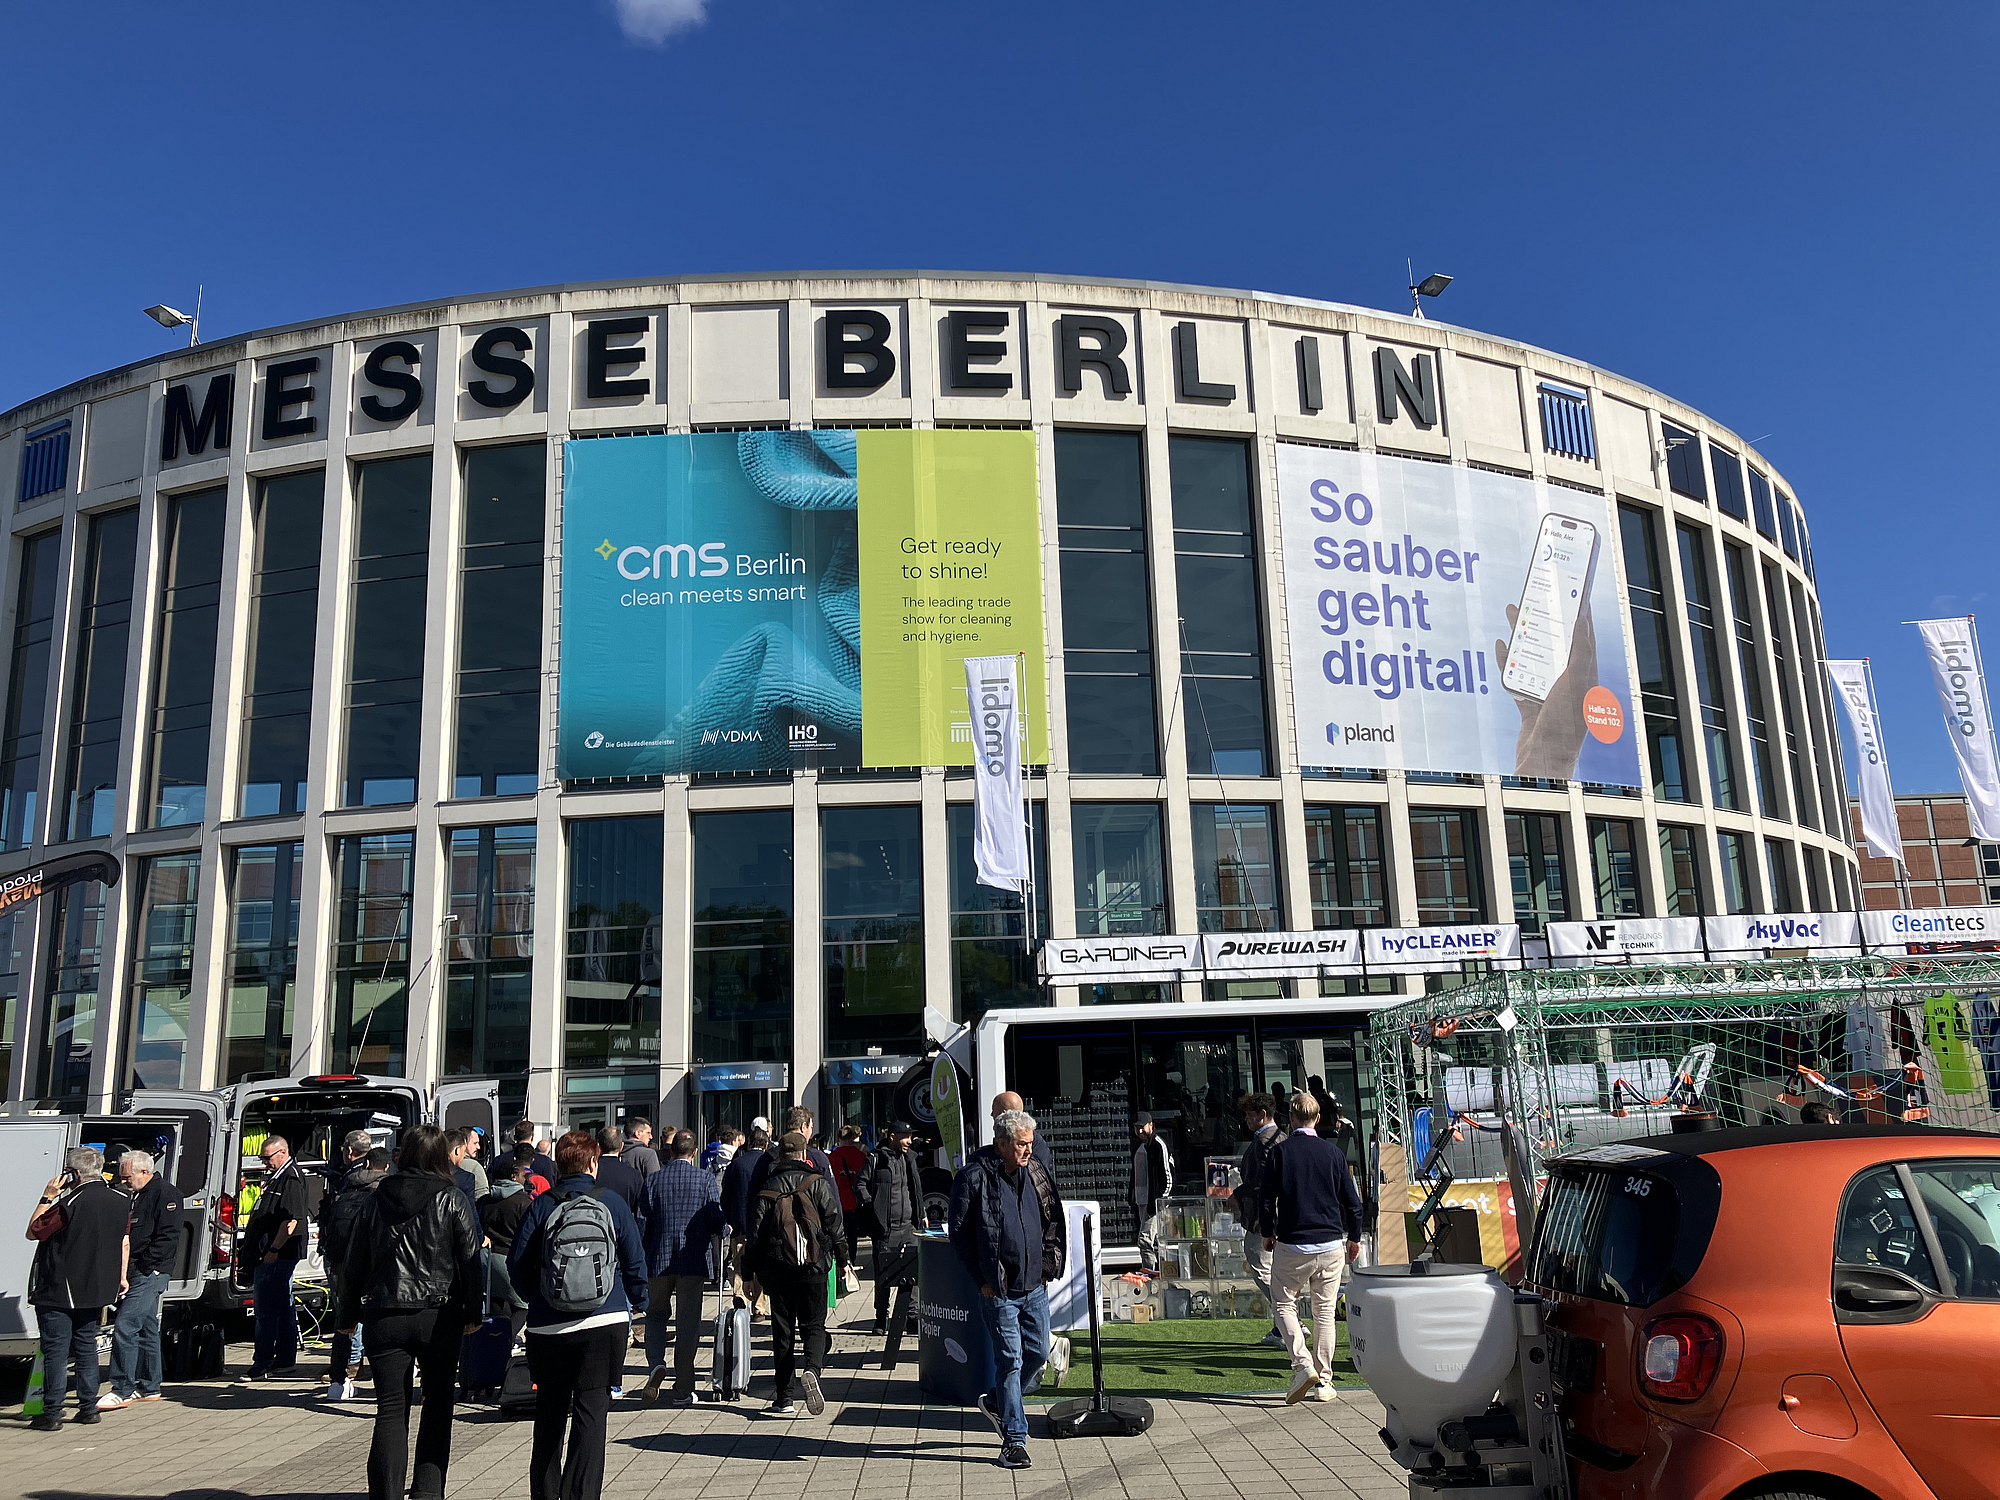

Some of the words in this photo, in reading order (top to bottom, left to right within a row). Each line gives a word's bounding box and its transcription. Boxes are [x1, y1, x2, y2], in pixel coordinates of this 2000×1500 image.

[161, 317, 651, 461] MESSE
[825, 309, 1438, 425] BERLIN
[1310, 479, 1373, 526] So
[901, 537, 938, 555] Get
[945, 537, 1002, 559] ready
[617, 542, 729, 580] cms
[736, 554, 806, 576] Berlin
[1314, 534, 1480, 583] sauber
[902, 563, 923, 579] to
[929, 561, 988, 579] shine!
[620, 588, 673, 607] clean
[679, 586, 743, 604] meets
[747, 583, 806, 601] smart
[902, 596, 925, 608] The
[928, 596, 974, 612] leading
[977, 596, 1011, 608] trade
[1317, 584, 1432, 635] geht
[902, 613, 935, 625] show
[938, 612, 955, 625] for
[959, 612, 1012, 628] cleaning
[902, 630, 926, 642] and
[930, 629, 982, 645] hygiene.
[1322, 640, 1489, 700] digital!
[1939, 640, 1976, 737] lidomo
[1588, 705, 1605, 714] Halle
[1606, 707, 1617, 716] 3.2
[981, 678, 1011, 777] lidomo
[1587, 715, 1607, 725] Stand
[1608, 717, 1621, 727] 102
[1843, 680, 1878, 765] lidomo
[616, 739, 675, 748] Gebäudedienstleister
[721, 730, 762, 742] VDMA
[1344, 723, 1395, 745] pland
[0, 869, 43, 893] Prod
[1892, 915, 1985, 932] Cleantecs
[1618, 933, 1663, 941] REINIGUNGS
[1060, 945, 1187, 963] GARDINER
[1217, 940, 1347, 960] PUREWASH
[863, 1065, 904, 1075] NILFISK
[1624, 1176, 1652, 1197] 345
[921, 1318, 941, 1338] Papier
